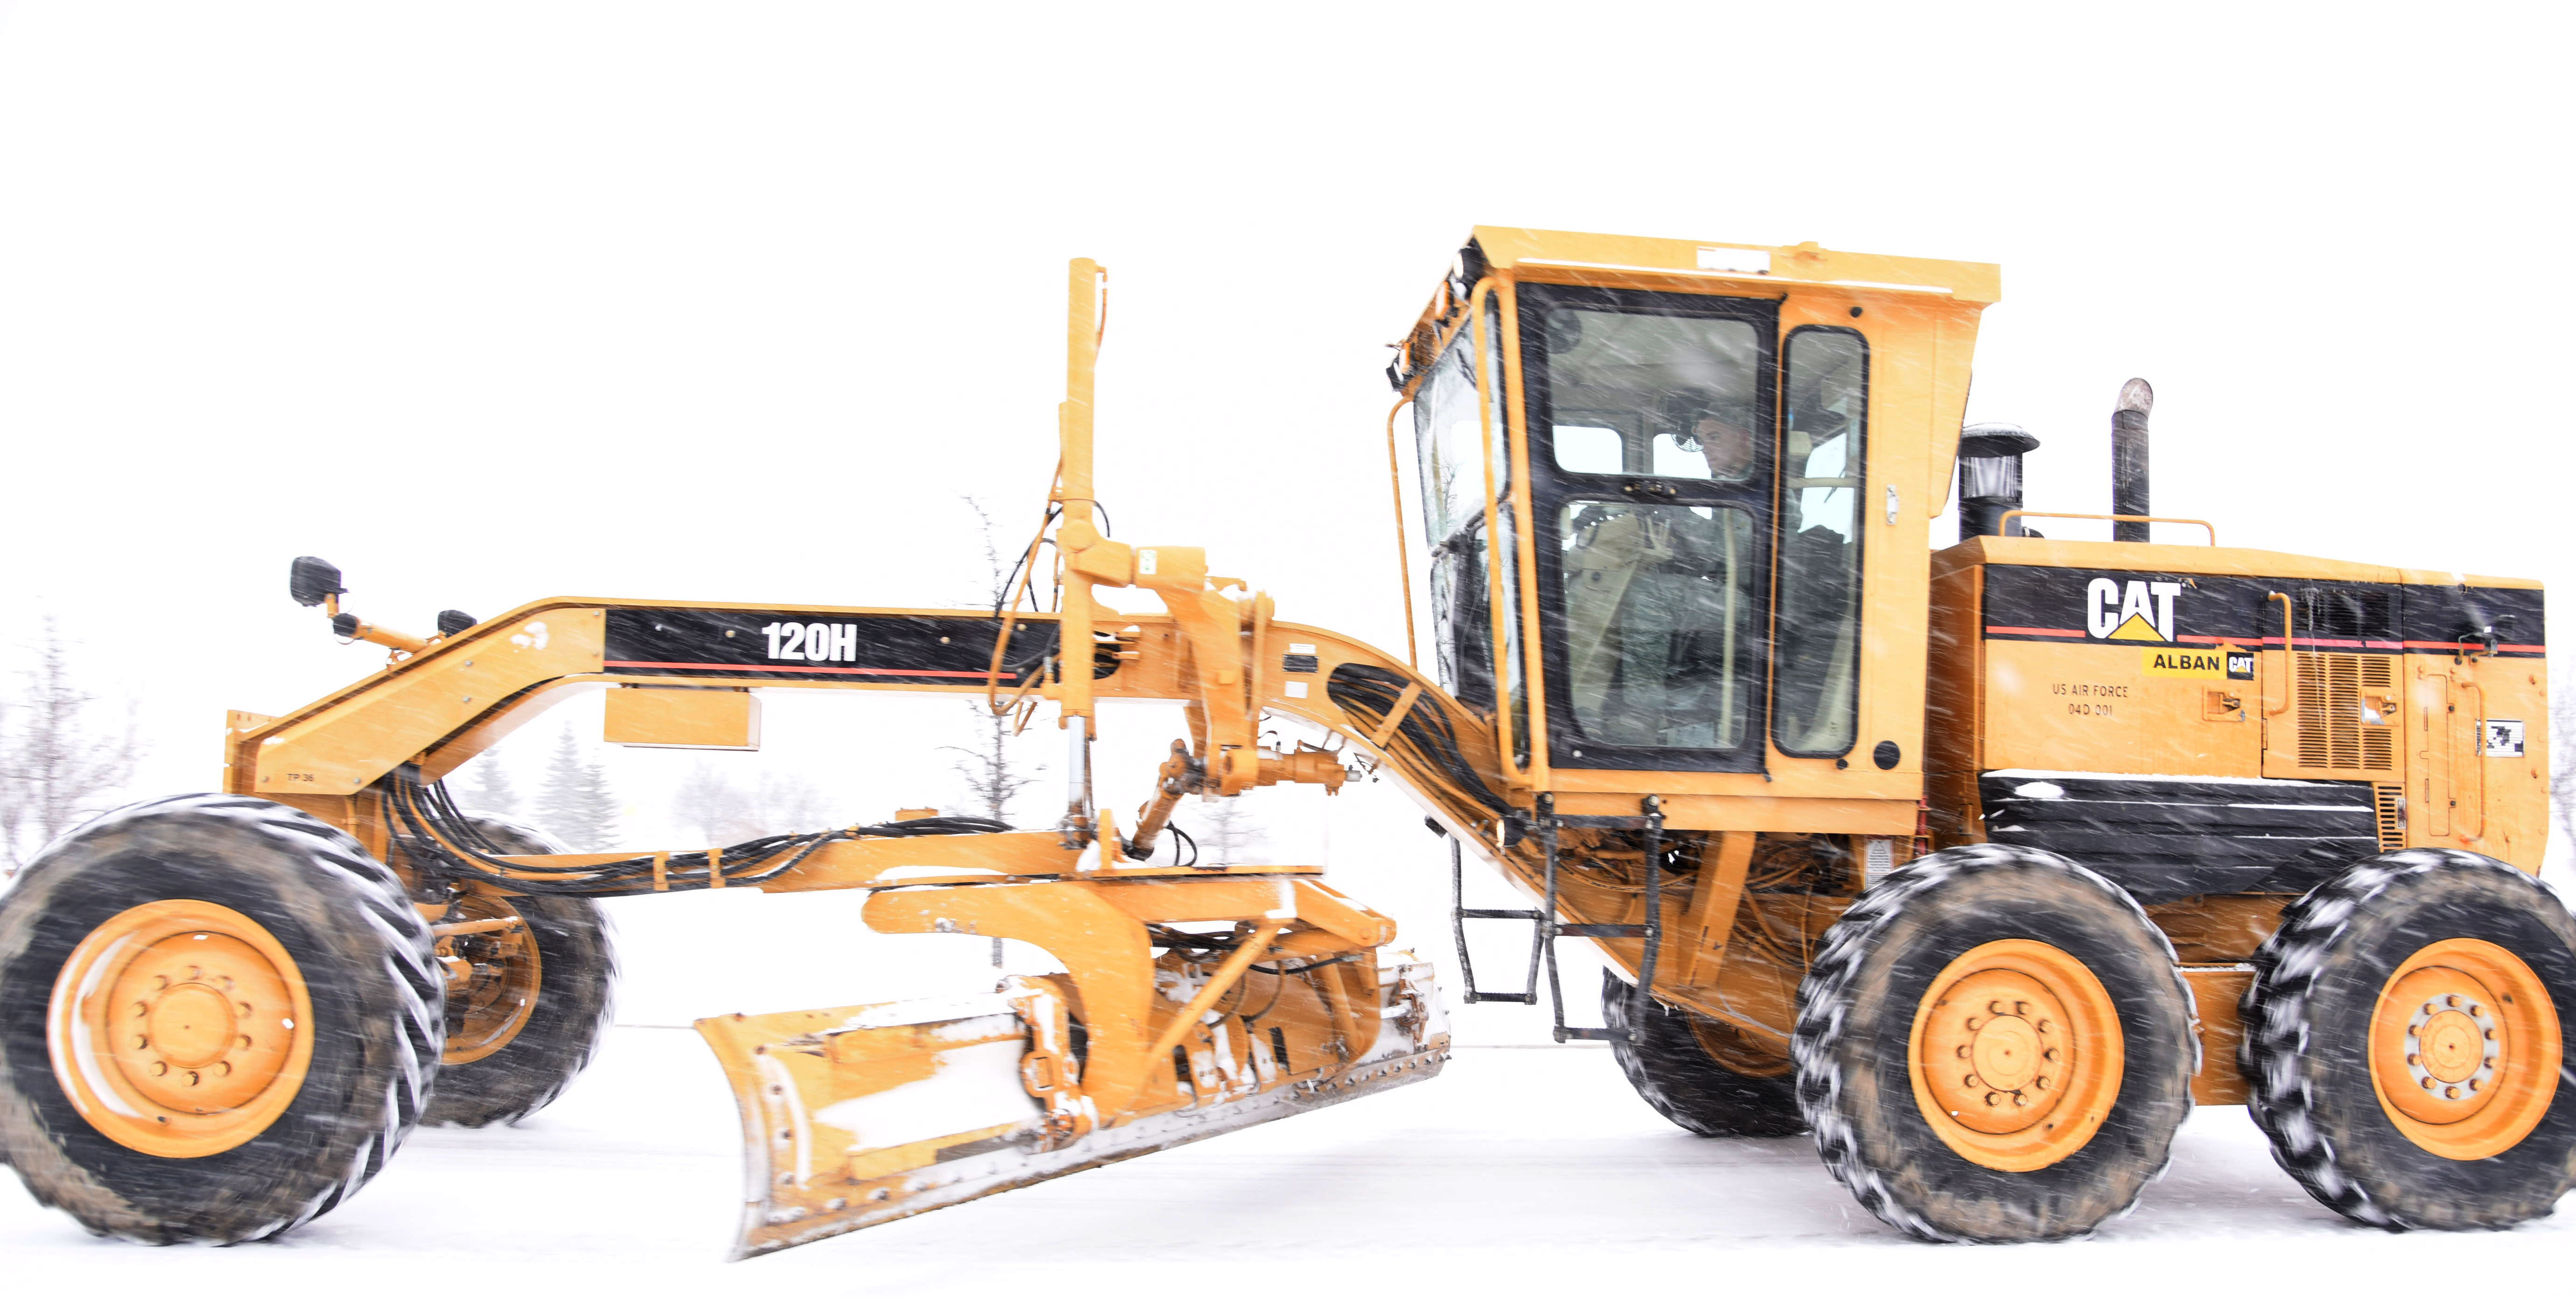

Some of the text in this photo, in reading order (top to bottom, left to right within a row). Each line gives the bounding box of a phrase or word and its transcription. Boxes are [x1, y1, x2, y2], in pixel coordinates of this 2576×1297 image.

[2088, 578, 2181, 642] CAT
[762, 622, 857, 662] 120H
[2154, 654, 2253, 673] ALBAN CAT
[2052, 683, 2128, 697] US AIR FORCE
